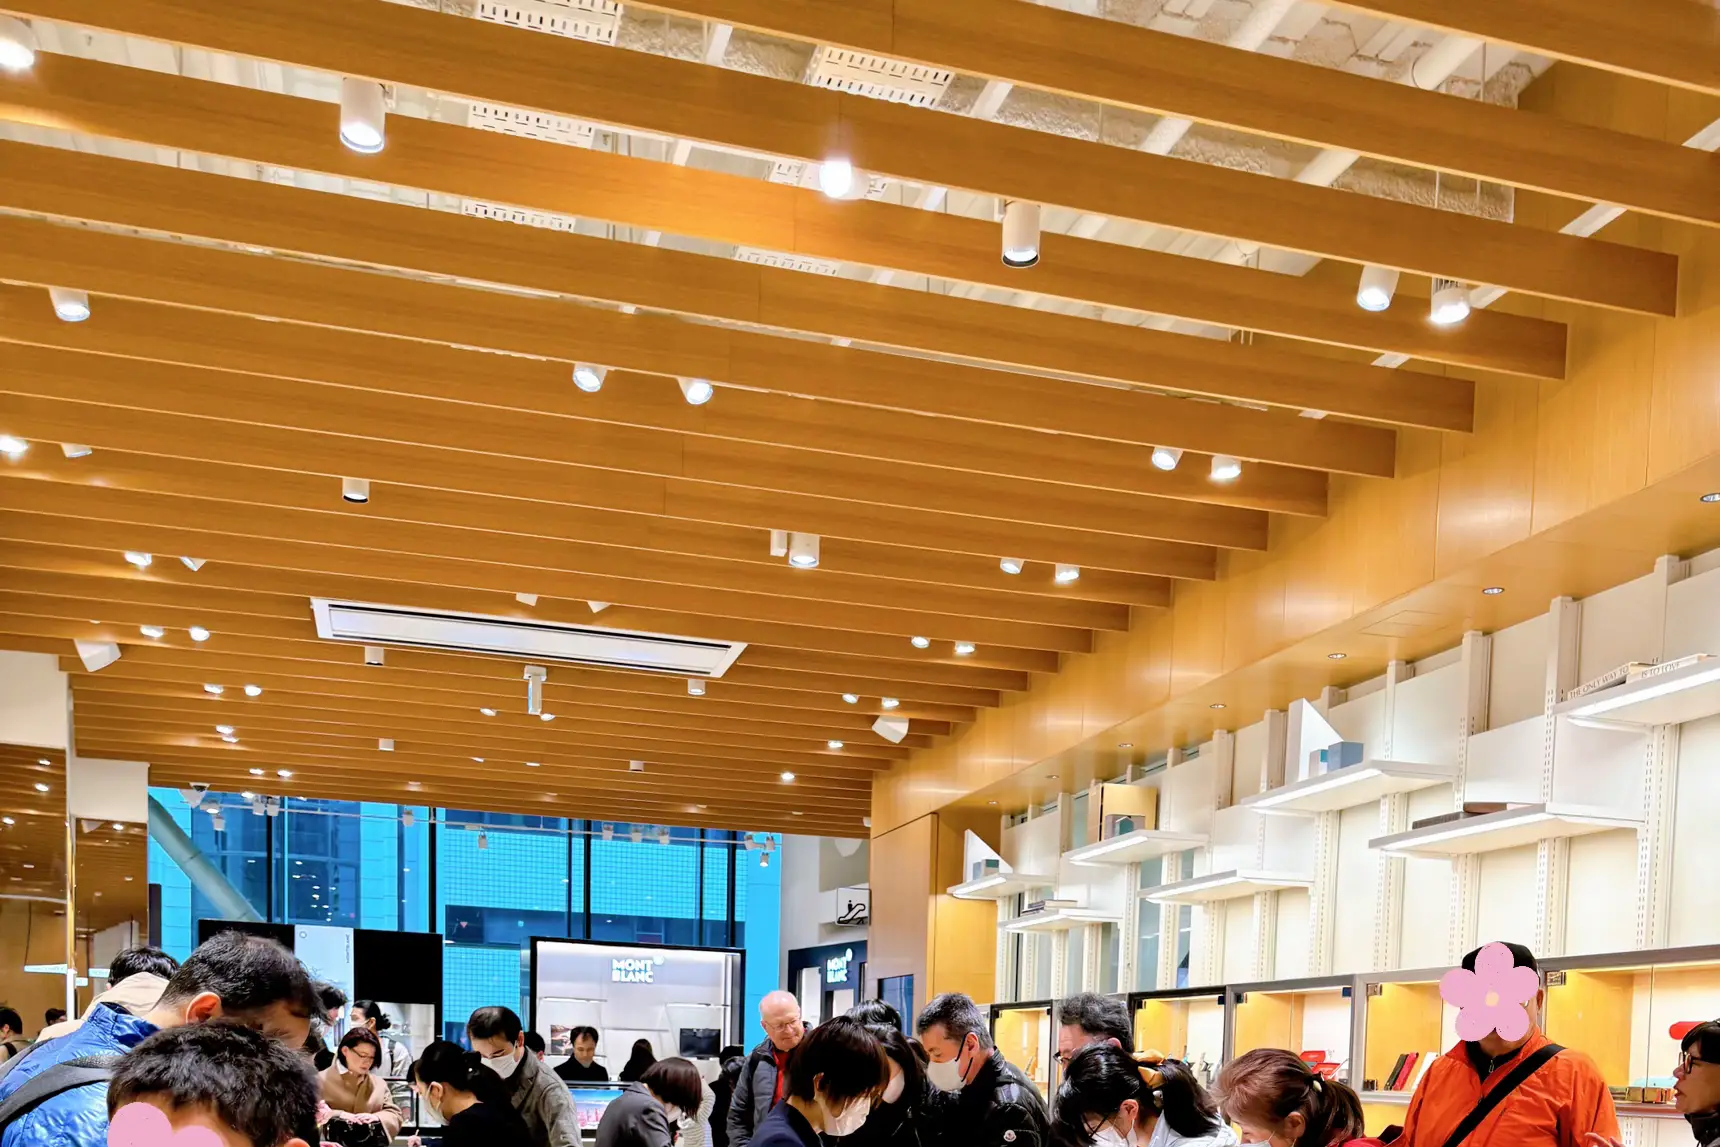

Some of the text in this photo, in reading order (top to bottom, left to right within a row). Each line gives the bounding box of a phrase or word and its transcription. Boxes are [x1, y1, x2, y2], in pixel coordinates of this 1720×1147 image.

[1641, 661, 1681, 679] IS TO LOVE
[1570, 666, 1630, 700] THE ONLY WAY TO
[612, 958, 654, 971] MONT
[612, 970, 654, 983] BLANC
